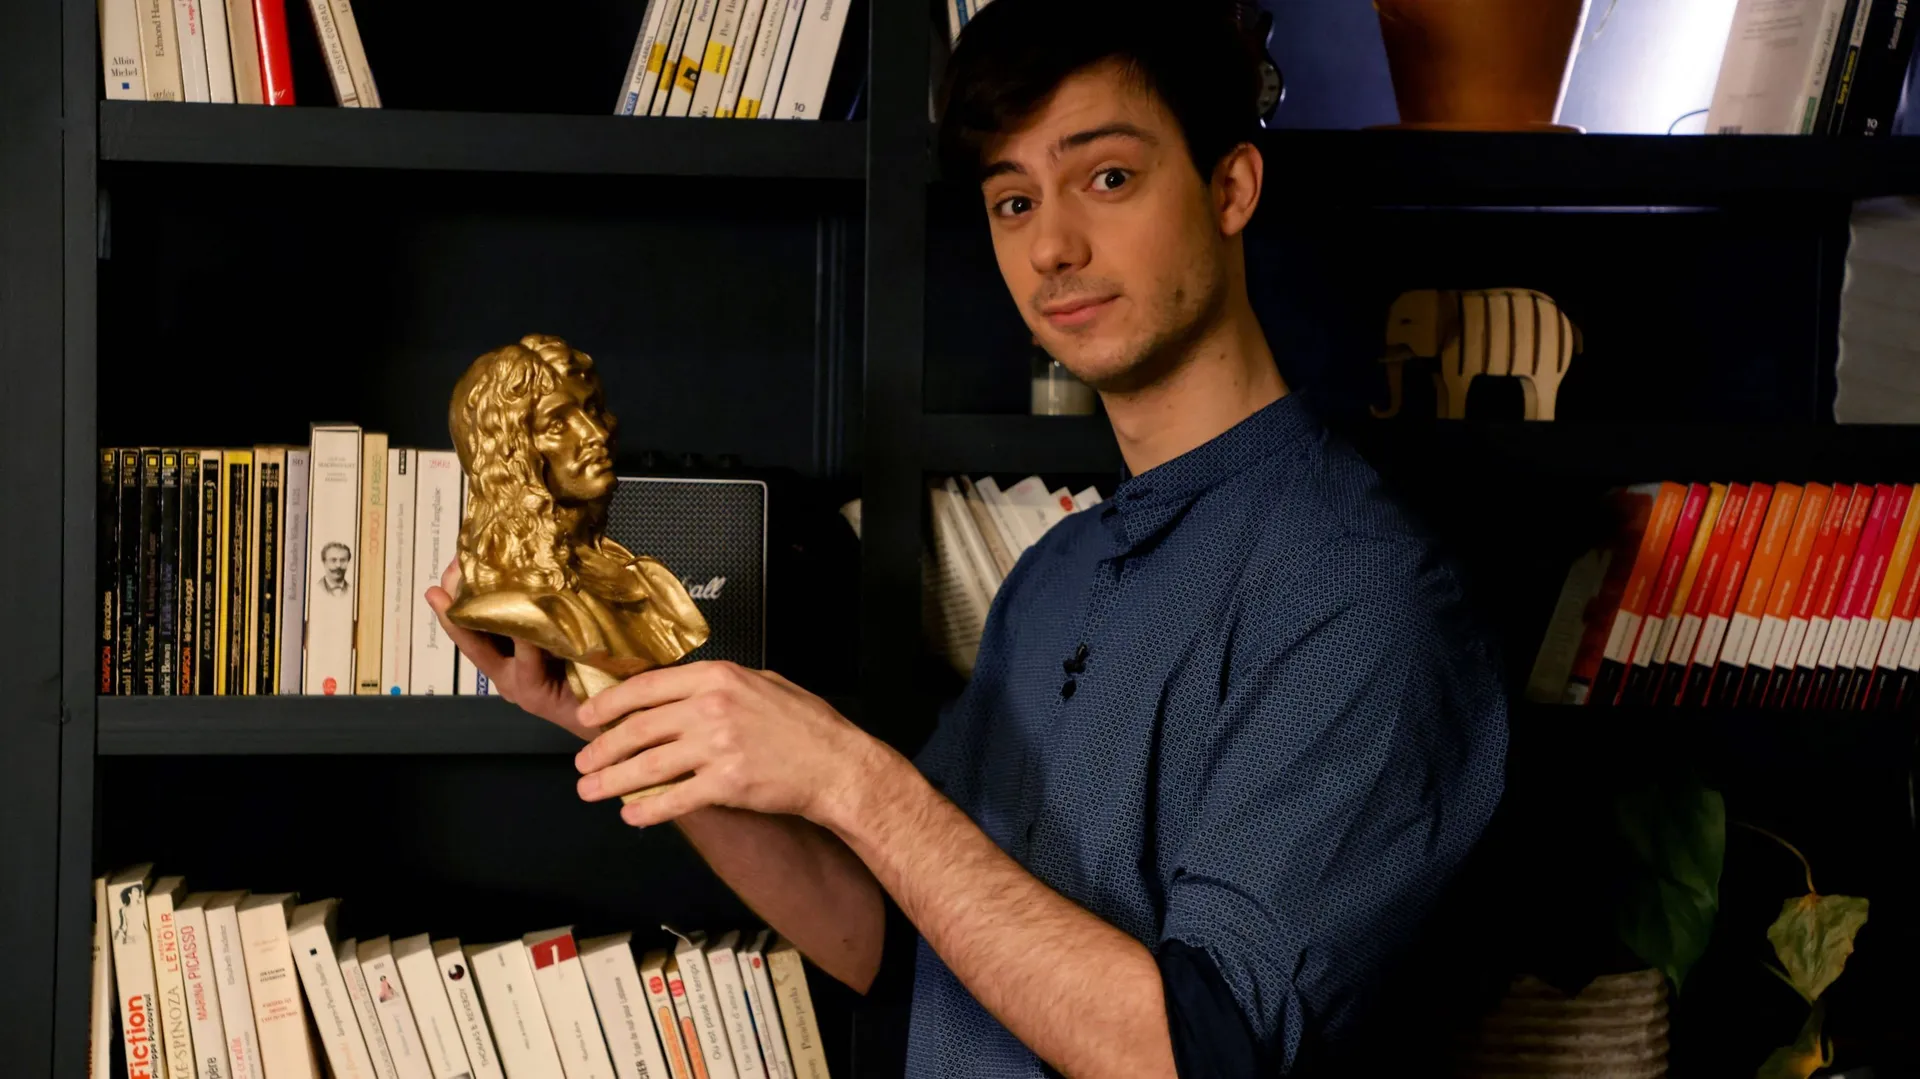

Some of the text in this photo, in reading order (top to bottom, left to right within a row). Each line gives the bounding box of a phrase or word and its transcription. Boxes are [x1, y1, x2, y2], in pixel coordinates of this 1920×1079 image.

[152, 20, 164, 57] Edmond
[318, 3, 347, 75] JOSEPH CONRAD
[111, 68, 138, 77] Michel
[112, 56, 134, 65] Albin
[634, 64, 644, 84] LEWIS
[794, 102, 805, 113] 10
[430, 487, 442, 527] l'anglaise
[429, 536, 439, 580] Testament
[161, 642, 171, 672] Brown
[181, 646, 191, 695] THOMPSON
[161, 673, 171, 696] edric
[161, 912, 178, 973] LENOIR
[181, 925, 208, 1021] MARINA PICASSO
[127, 994, 150, 1079] Fiction
[168, 986, 189, 1049] SPINOZA
